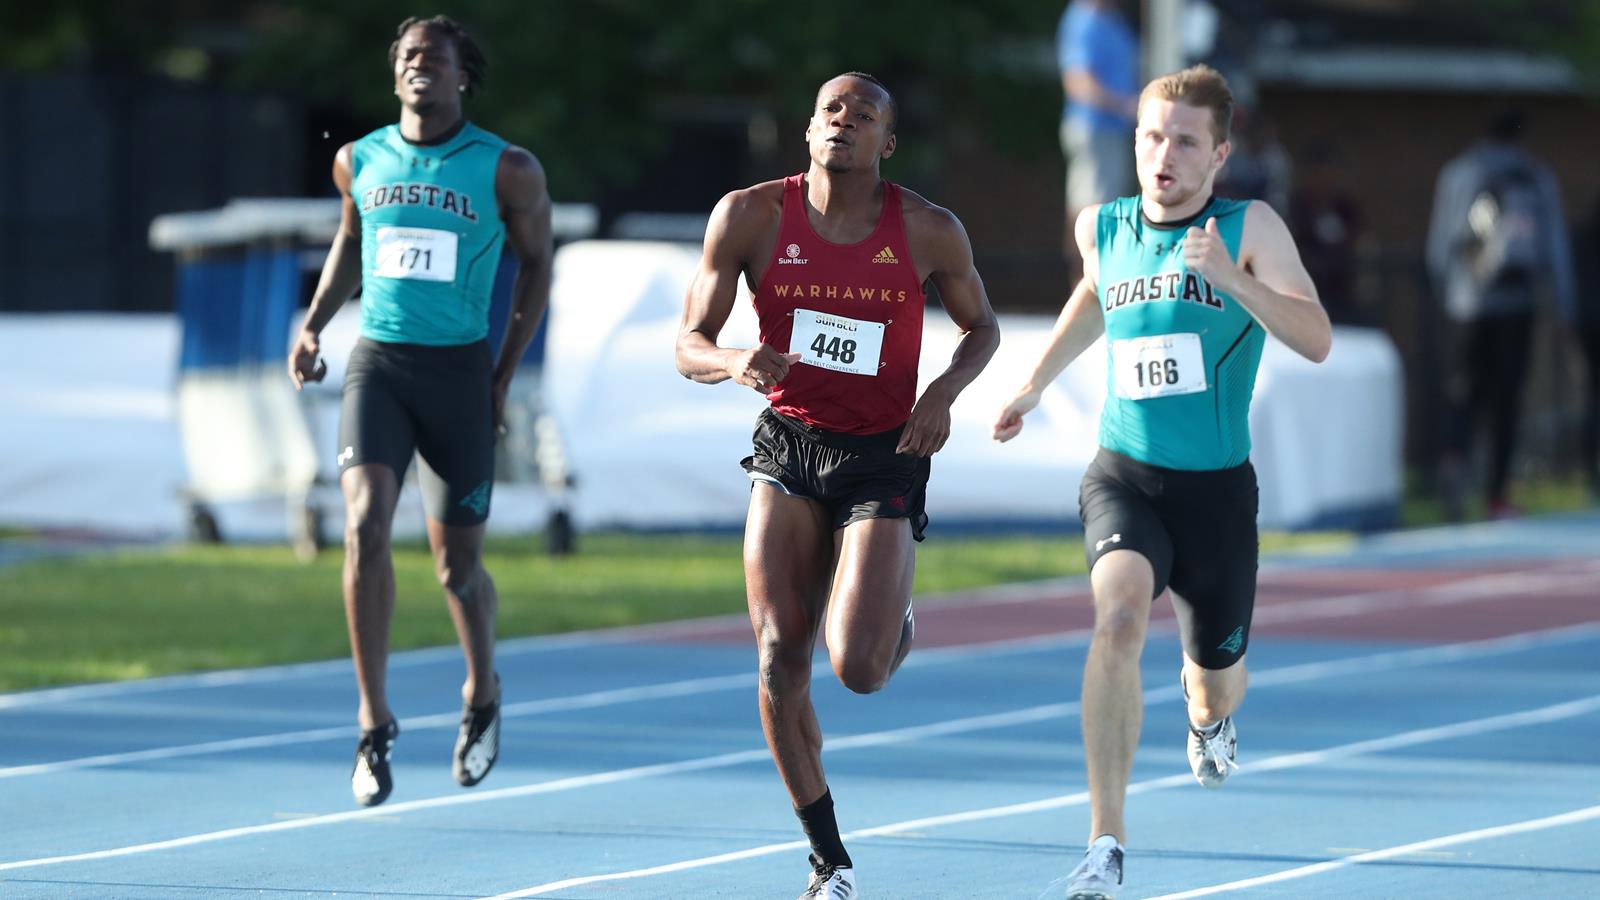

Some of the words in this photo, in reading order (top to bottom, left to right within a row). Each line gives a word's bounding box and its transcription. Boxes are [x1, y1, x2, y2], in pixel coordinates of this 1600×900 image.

[362, 181, 479, 224] COASTAL
[778, 257, 793, 265] SUN
[872, 256, 898, 264] adidas
[774, 284, 907, 303] WARHAWKS
[1104, 270, 1224, 312] COASTAL
[815, 314, 836, 328] SUN
[836, 318, 860, 332] BELT
[810, 332, 857, 364] 448
[826, 363, 860, 373] CONFERENCE
[1133, 357, 1179, 388] 166
